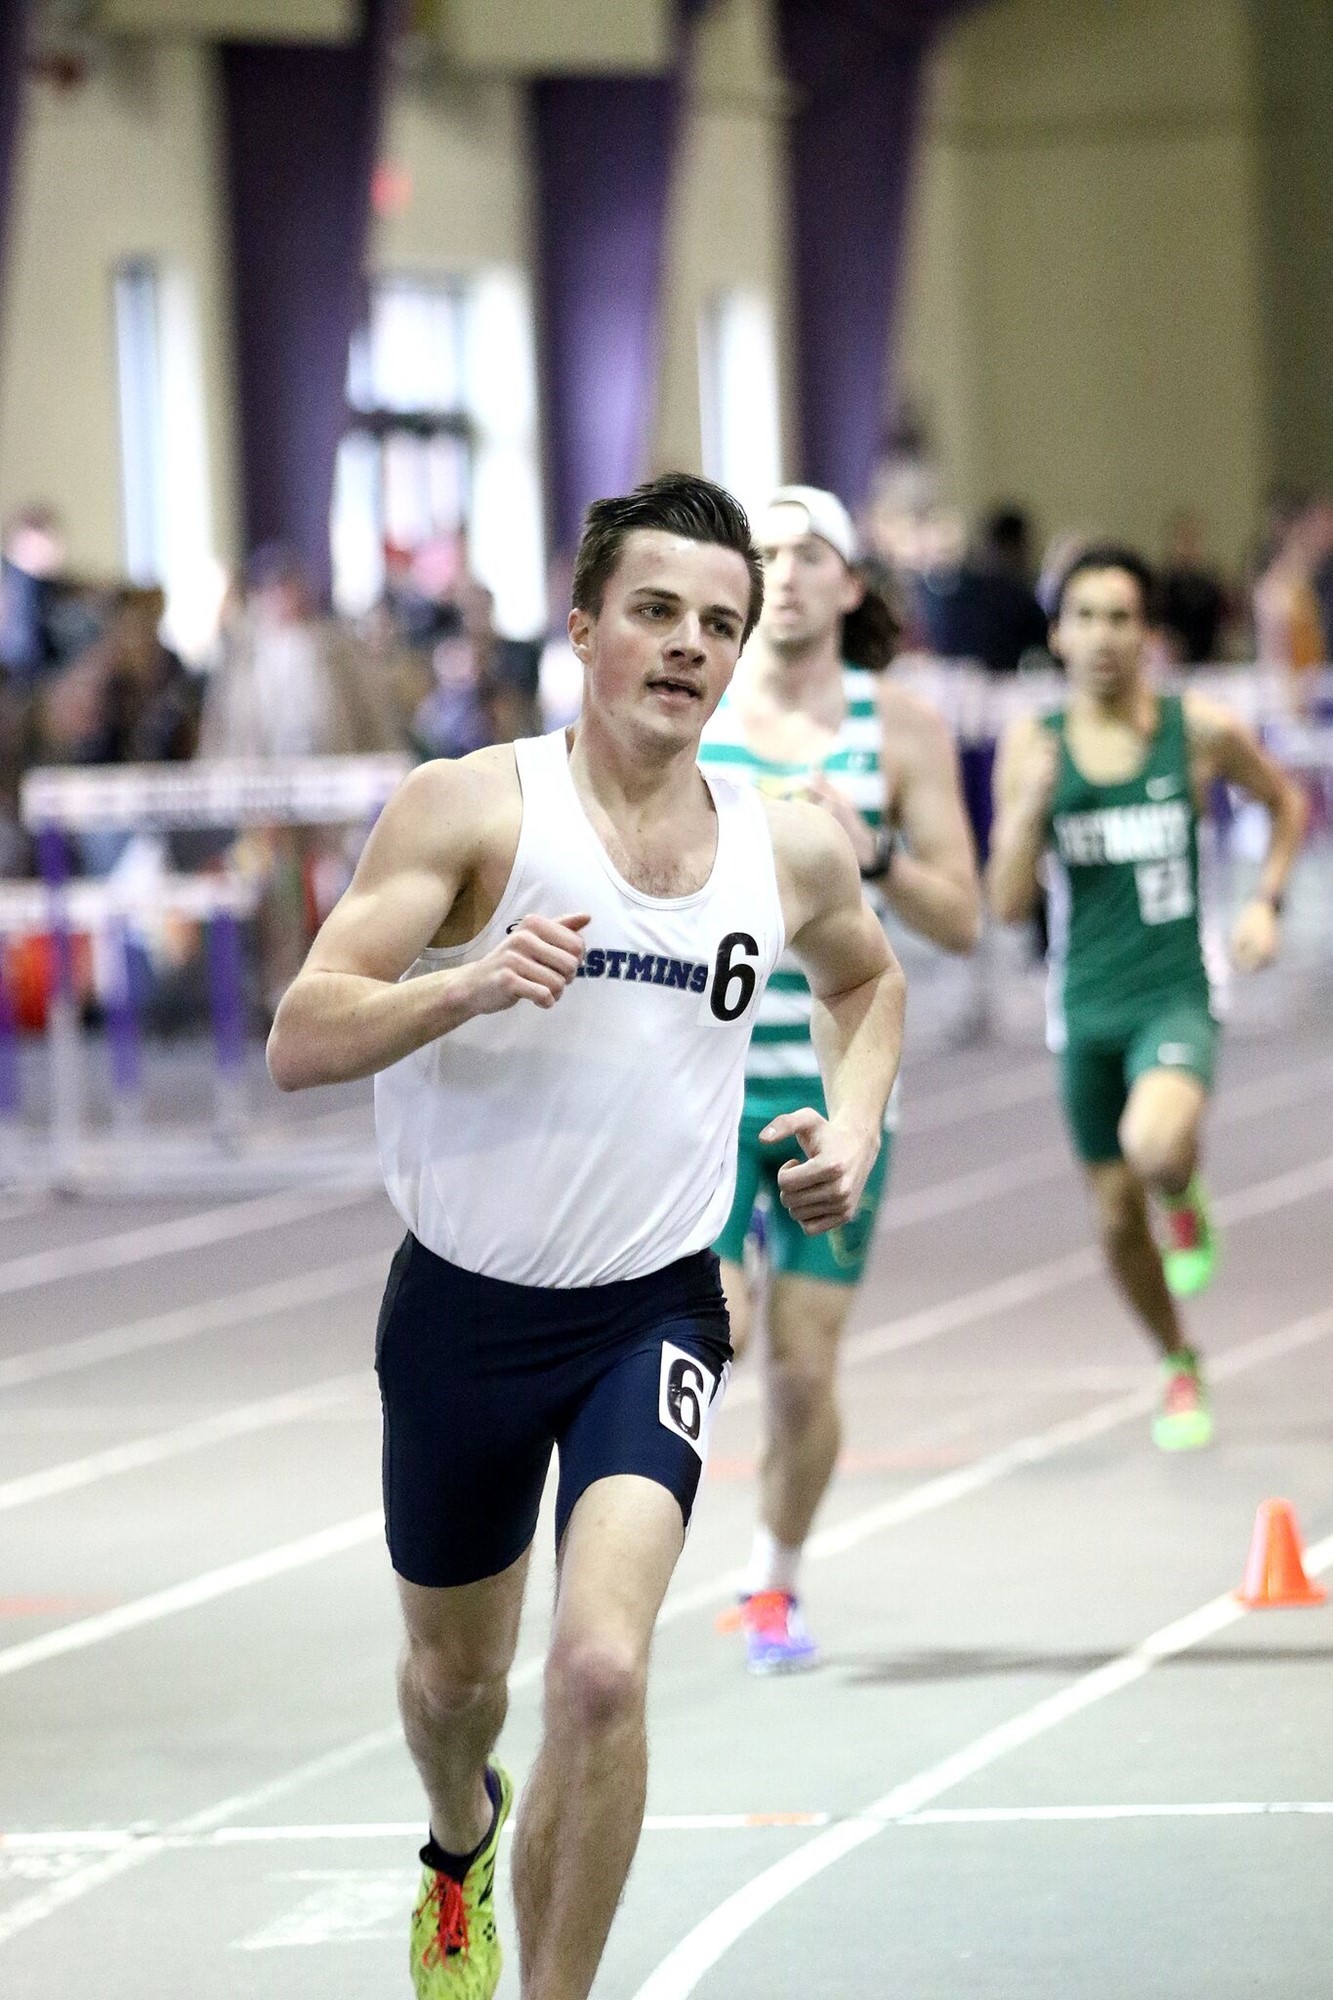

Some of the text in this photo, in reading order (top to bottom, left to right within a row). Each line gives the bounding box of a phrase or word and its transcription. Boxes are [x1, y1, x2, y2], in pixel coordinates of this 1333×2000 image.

[576, 948, 709, 993] STMINS
[709, 932, 760, 1021] 6
[667, 1358, 704, 1441] 6
